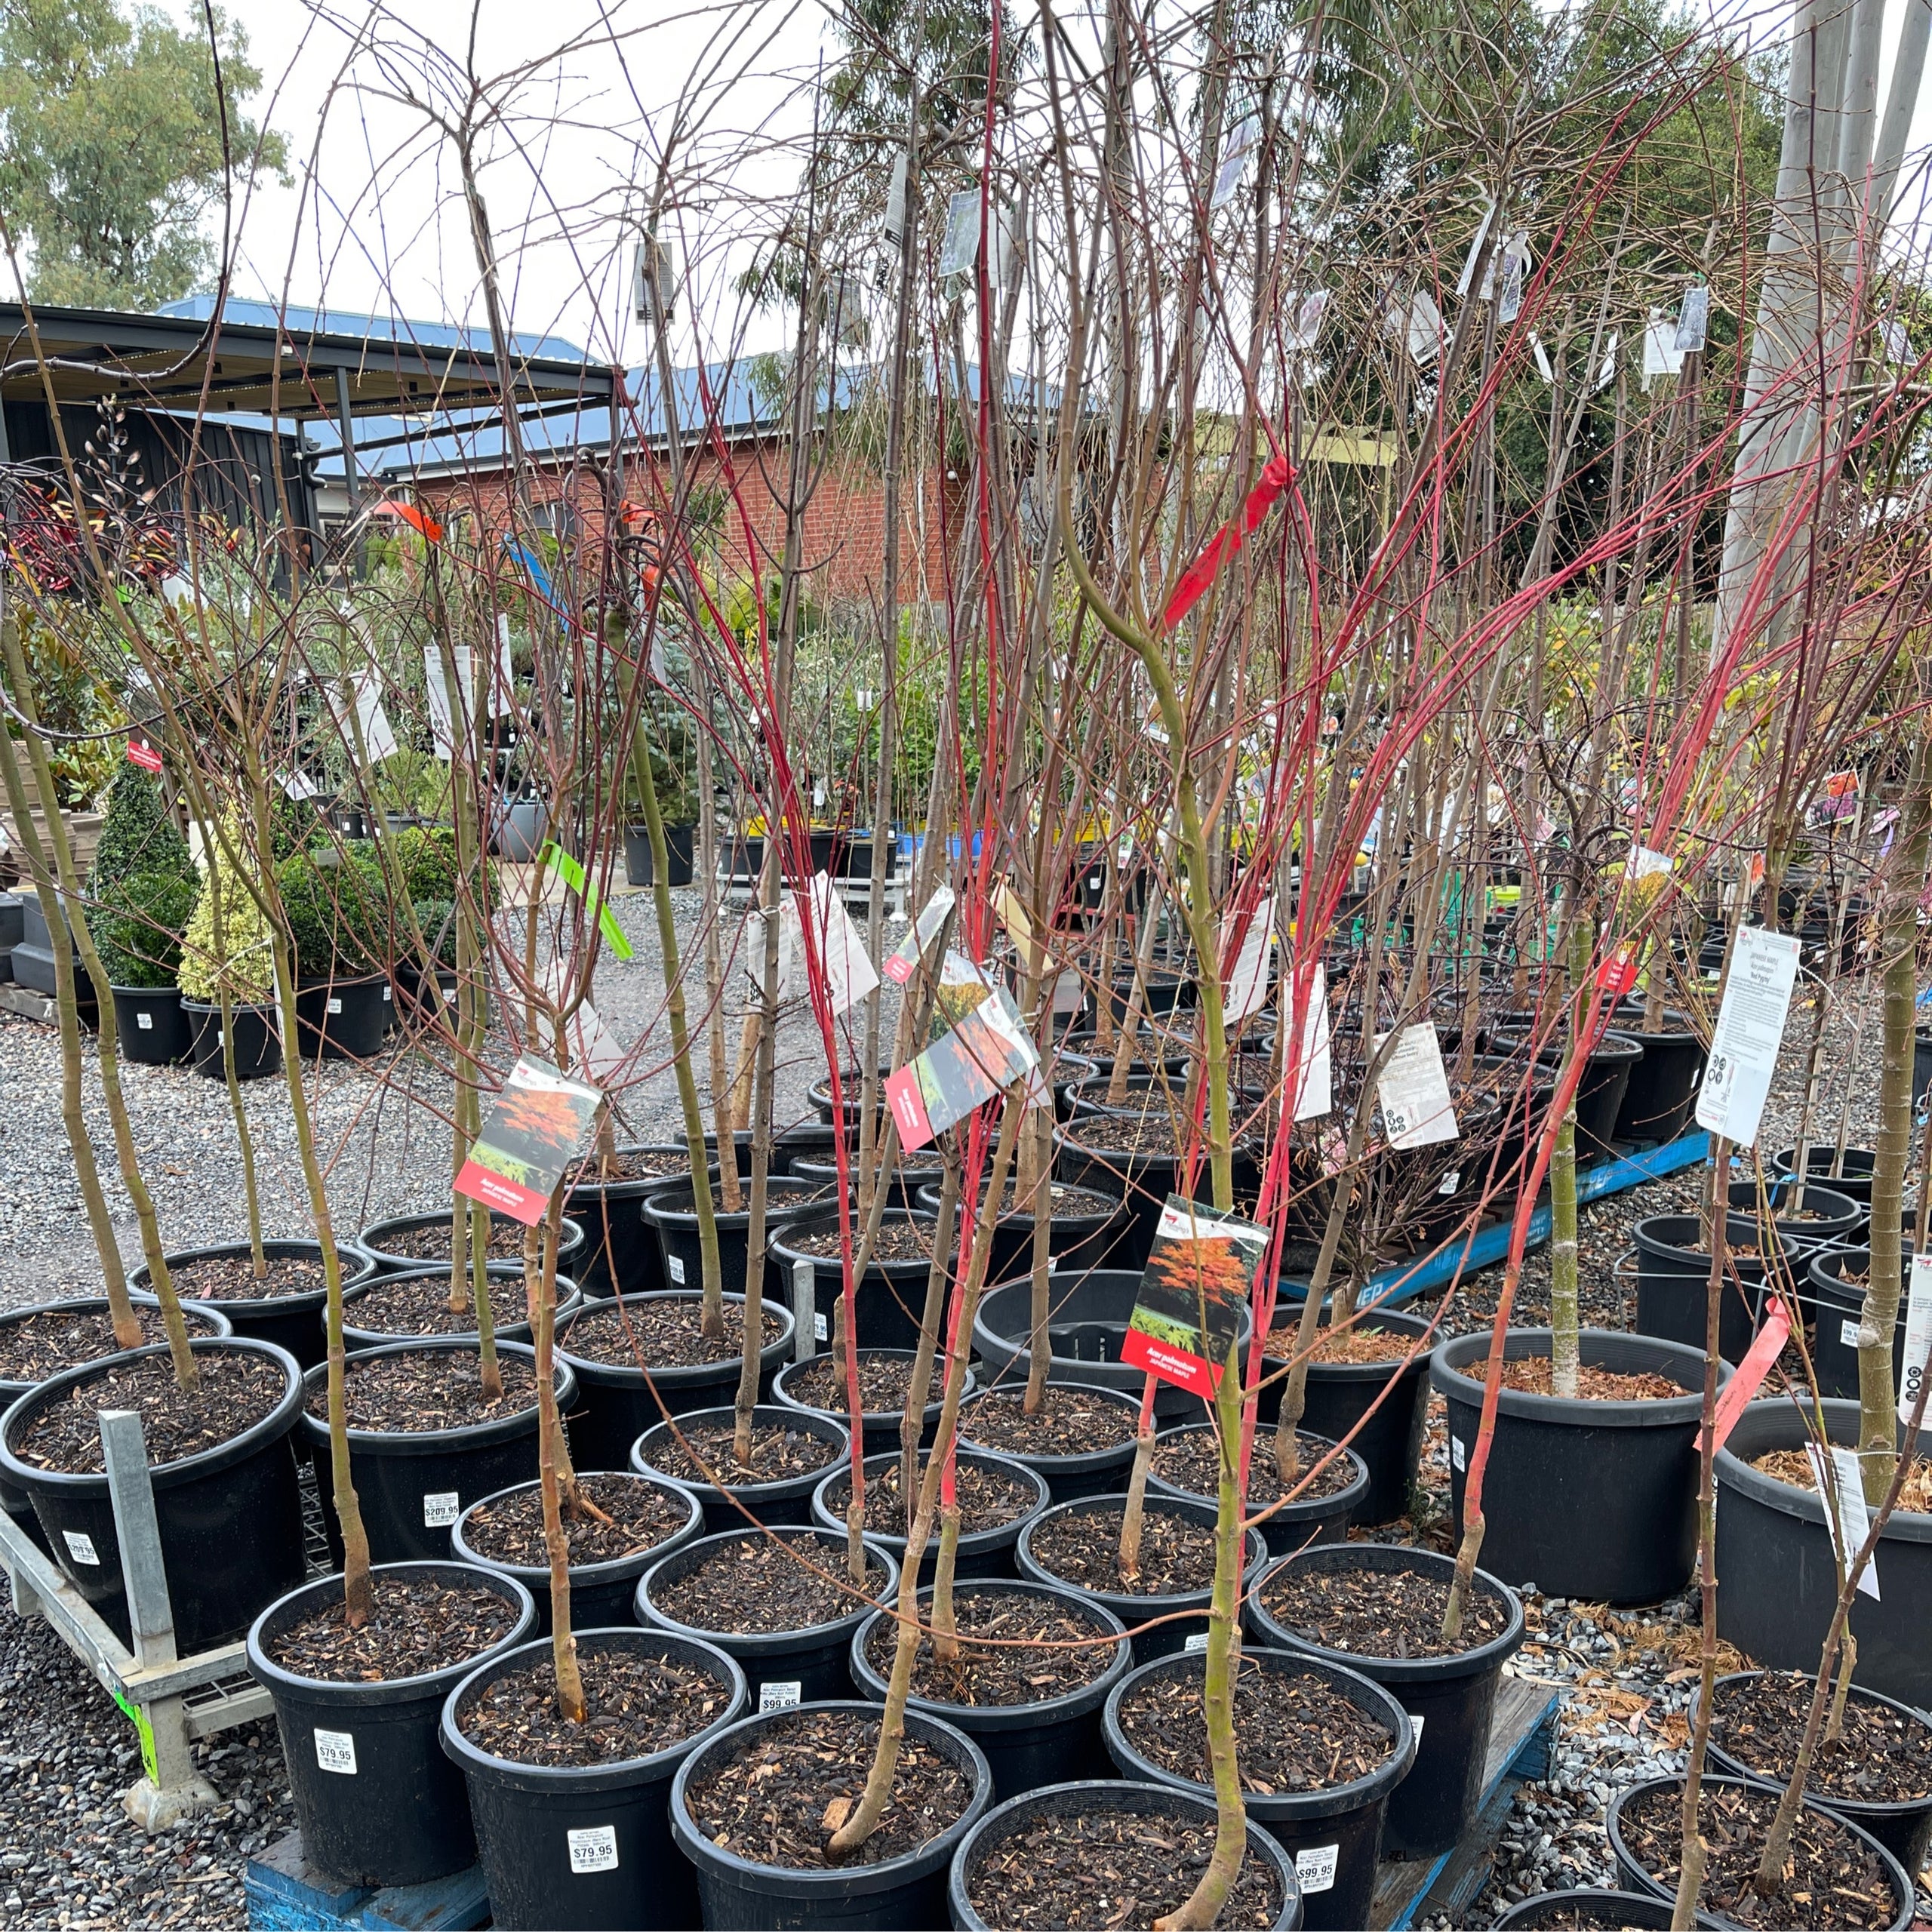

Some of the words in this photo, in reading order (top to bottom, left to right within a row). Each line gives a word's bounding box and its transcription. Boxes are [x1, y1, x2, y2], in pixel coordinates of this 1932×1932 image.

[1147, 1347, 1162, 1359] Acer
[1162, 1355, 1197, 1374] palmatum
[425, 1506, 458, 1516] $209.95
[319, 1746, 352, 1760] $79.95
[574, 1844, 613, 1858] $79.95
[1298, 1864, 1333, 1879] $99.95
